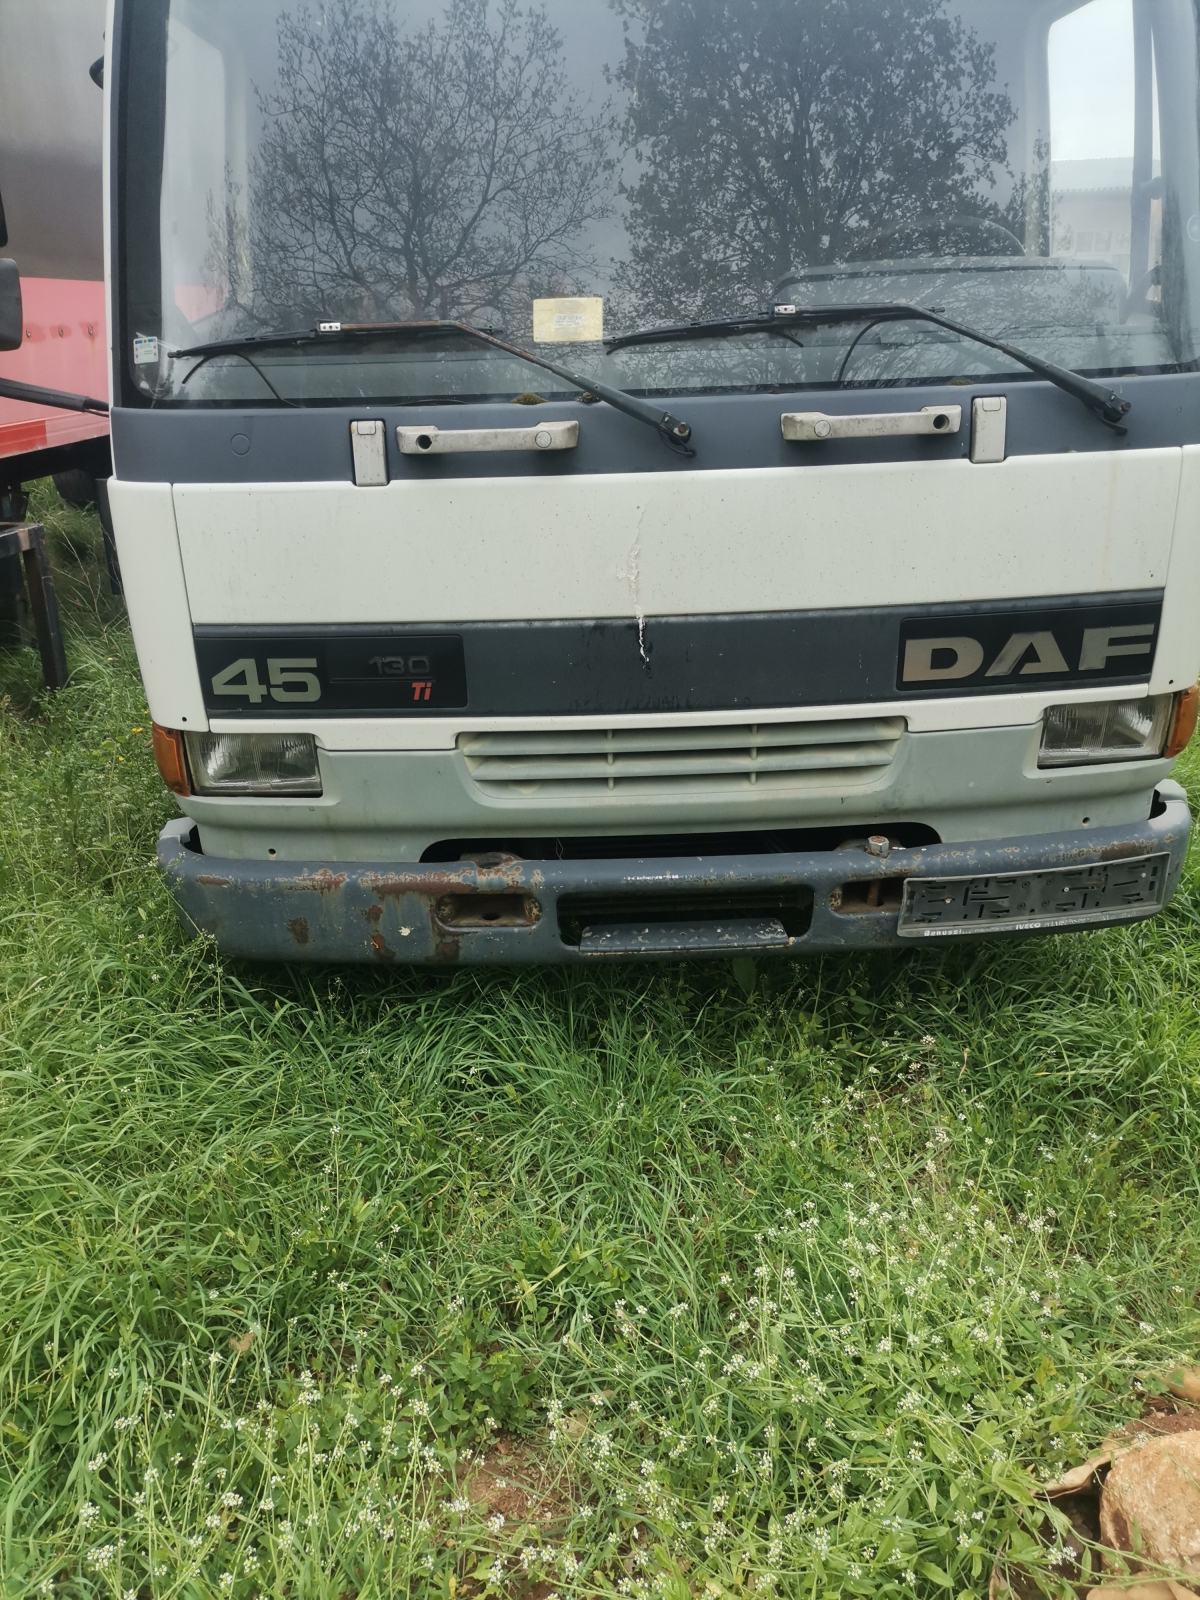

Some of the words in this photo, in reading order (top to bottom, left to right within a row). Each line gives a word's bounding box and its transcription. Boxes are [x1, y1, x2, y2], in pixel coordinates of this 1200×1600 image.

[902, 624, 1155, 682] DAF
[368, 655, 431, 675] 130
[211, 658, 322, 703] 45
[411, 682, 432, 701] Ti
[1015, 922, 1041, 930] IVECO
